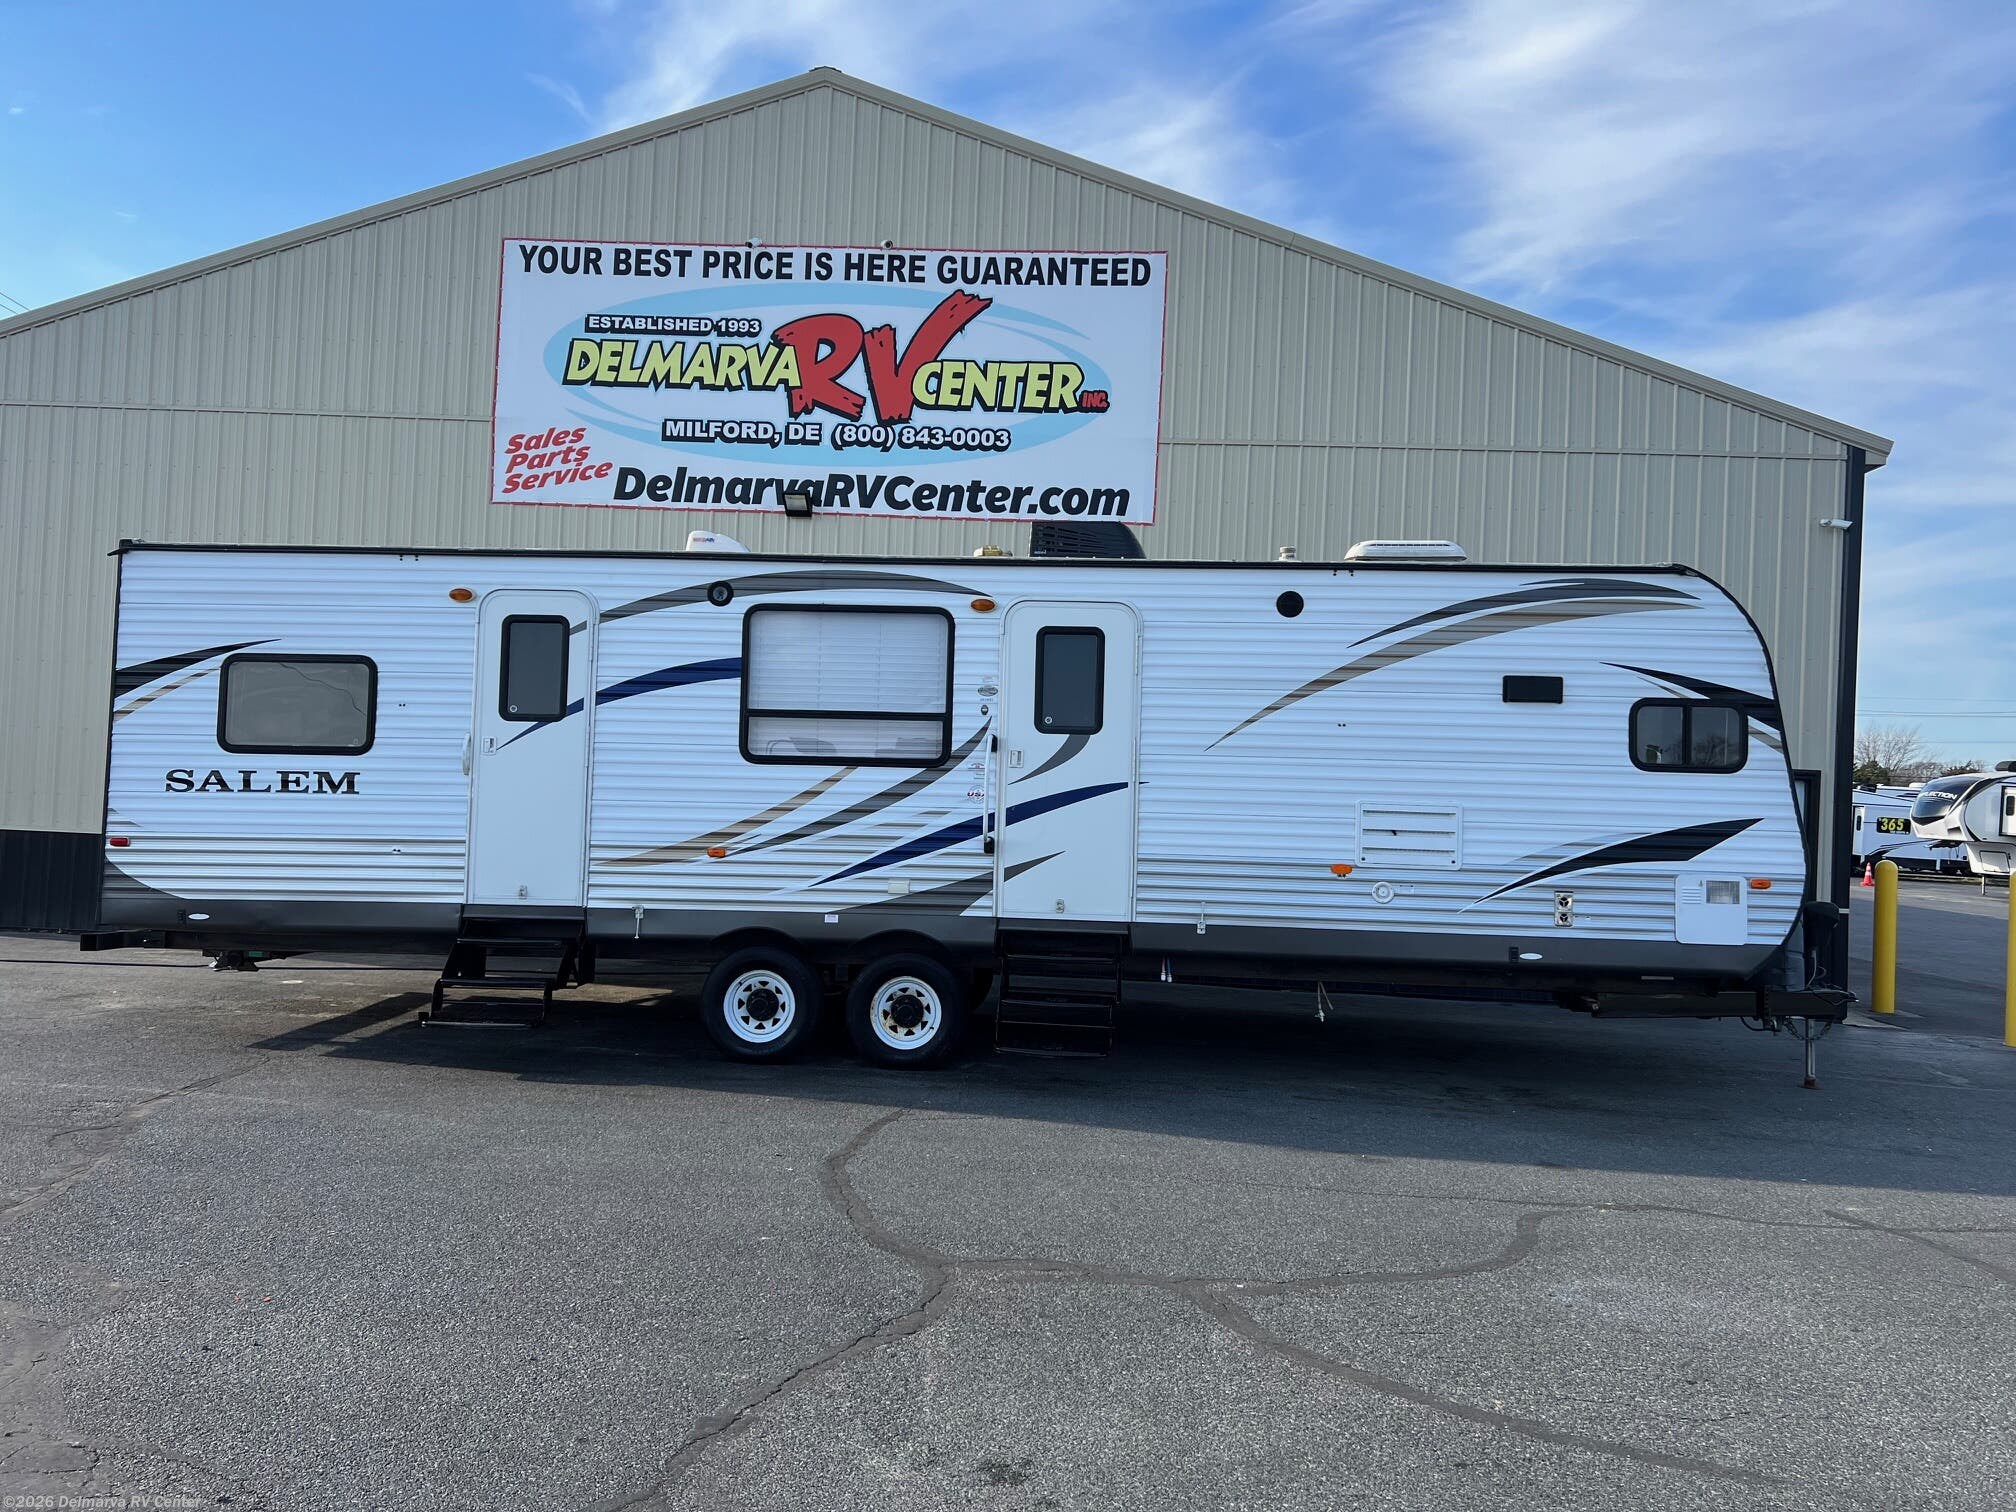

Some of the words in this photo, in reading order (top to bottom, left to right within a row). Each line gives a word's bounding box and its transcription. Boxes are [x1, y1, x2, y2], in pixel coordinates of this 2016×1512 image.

[519, 244, 602, 275] YOUR
[613, 248, 692, 278] BEST
[702, 250, 794, 280] PRICE
[804, 252, 833, 281] IS
[844, 253, 926, 283] HERE
[937, 256, 1151, 287] GUARANTEED
[586, 315, 713, 332] ESTABLISHED
[716, 319, 761, 335] 1993
[563, 338, 801, 390] DELMARVA
[771, 289, 993, 425] RV
[912, 361, 1084, 412] CENTER
[505, 428, 586, 454] Sales
[663, 420, 781, 446] MILFORD,
[786, 424, 821, 444] DE
[832, 424, 895, 450] (800)
[900, 427, 1010, 449] 843-0003
[505, 444, 590, 474] Parts
[502, 461, 613, 494] Service
[613, 466, 1130, 516] DelmarvaRVCenter.com
[165, 769, 360, 794] SALEM
